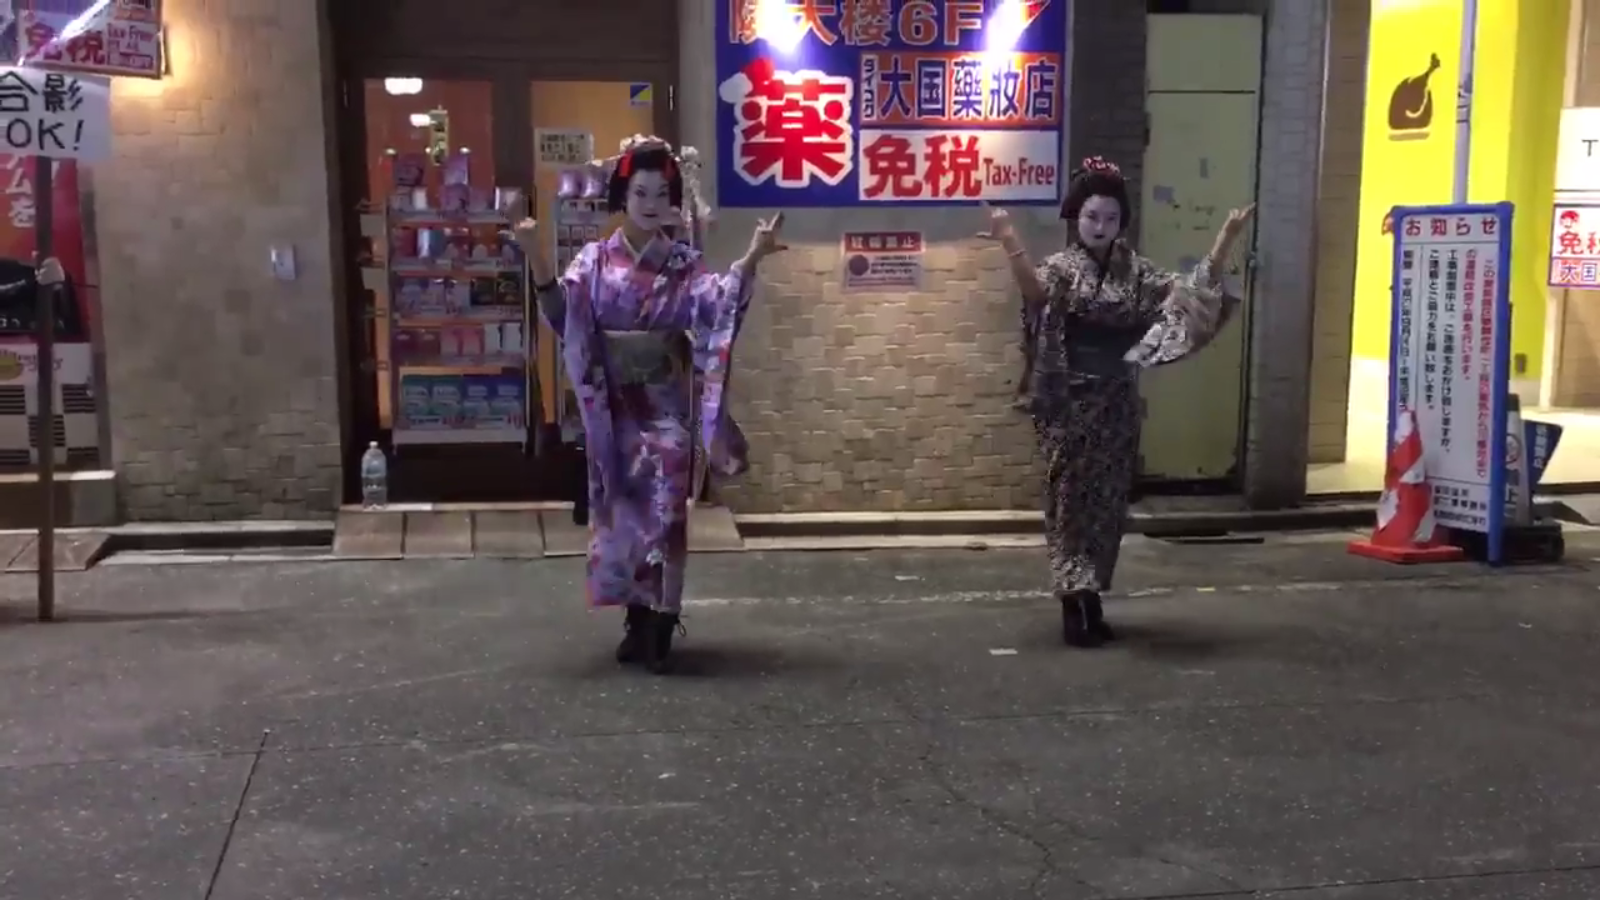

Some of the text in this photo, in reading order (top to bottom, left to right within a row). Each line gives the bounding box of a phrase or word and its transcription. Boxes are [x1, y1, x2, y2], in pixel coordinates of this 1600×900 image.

[0, 71, 84, 113] 合影
[6, 118, 85, 151] OK!
[862, 135, 983, 199] 免税
[983, 157, 1056, 187] Tax-Free
[1405, 218, 1497, 236] お知らせ
